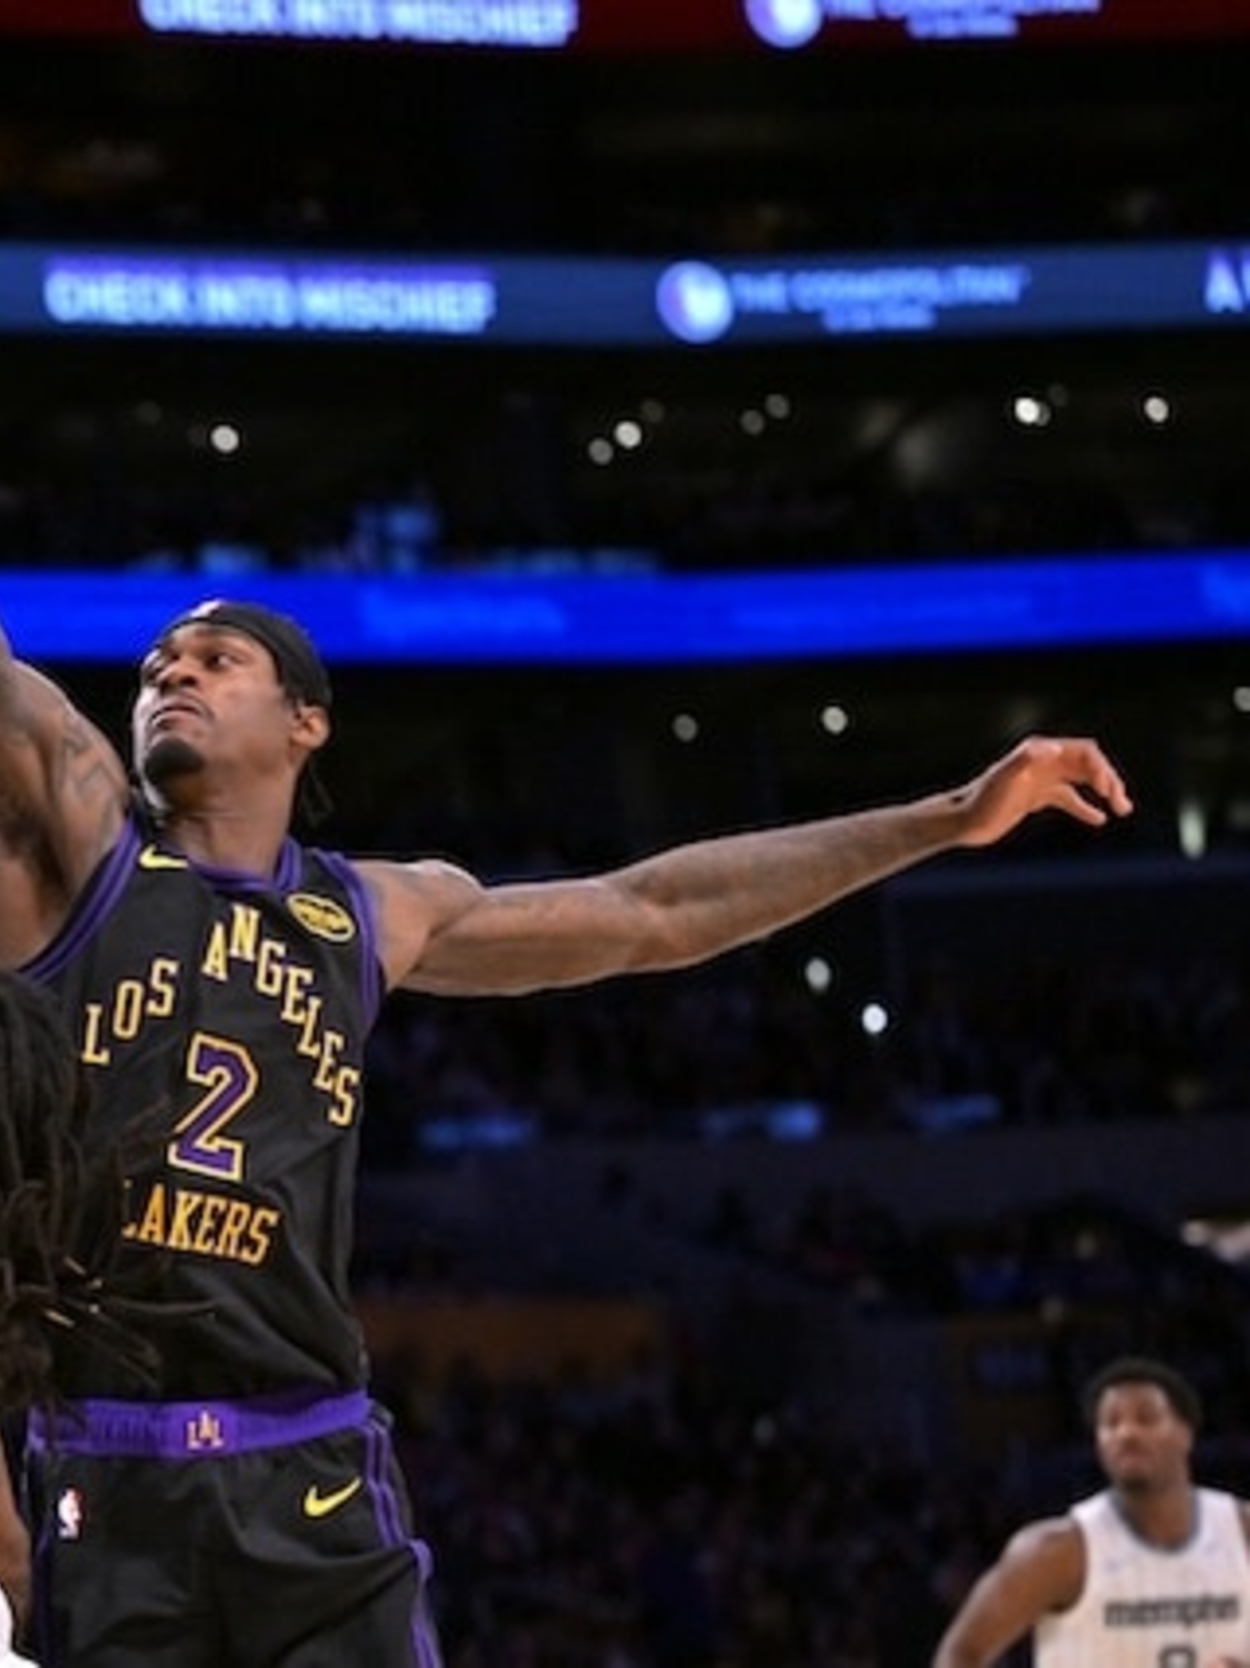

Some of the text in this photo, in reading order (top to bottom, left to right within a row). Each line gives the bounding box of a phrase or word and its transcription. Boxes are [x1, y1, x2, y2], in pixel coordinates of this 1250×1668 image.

[82, 903, 360, 1127] LOS ANGELES
[167, 1032, 259, 1182] 2
